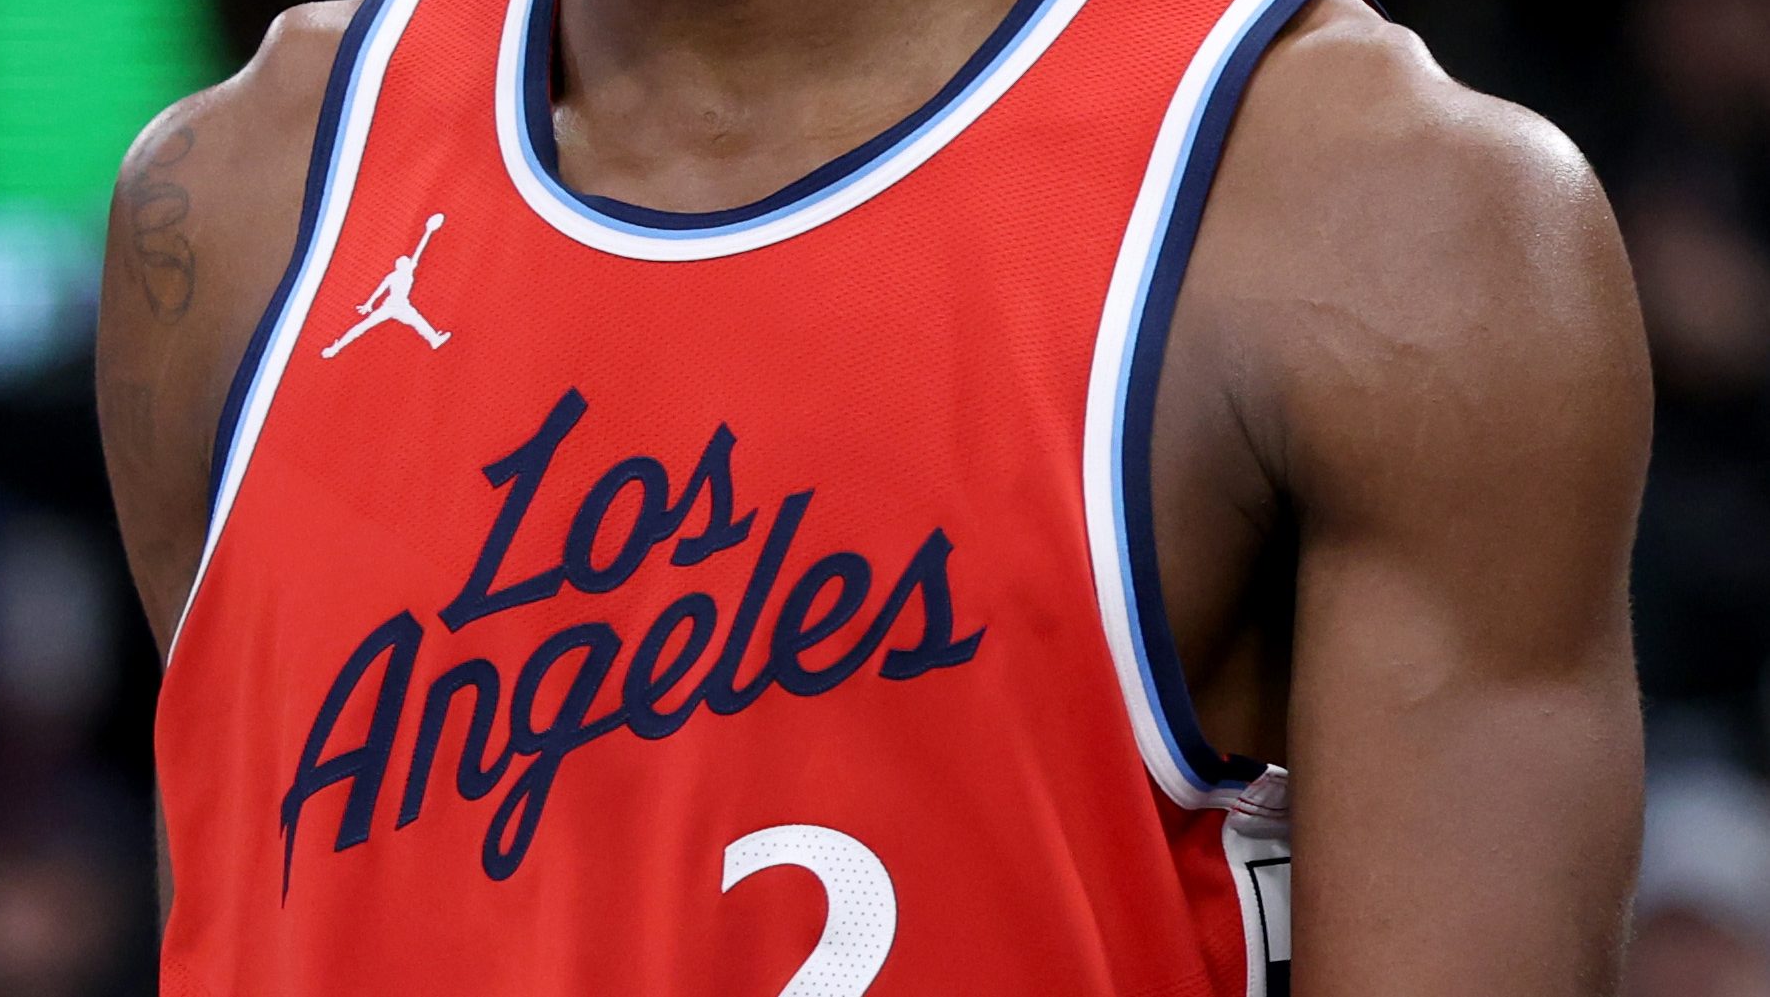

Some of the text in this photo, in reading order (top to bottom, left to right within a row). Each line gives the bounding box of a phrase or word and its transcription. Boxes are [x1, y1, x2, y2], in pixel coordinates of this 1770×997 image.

[438, 386, 758, 634] Los
[280, 488, 987, 909] Angeles
[721, 823, 897, 997] 2
